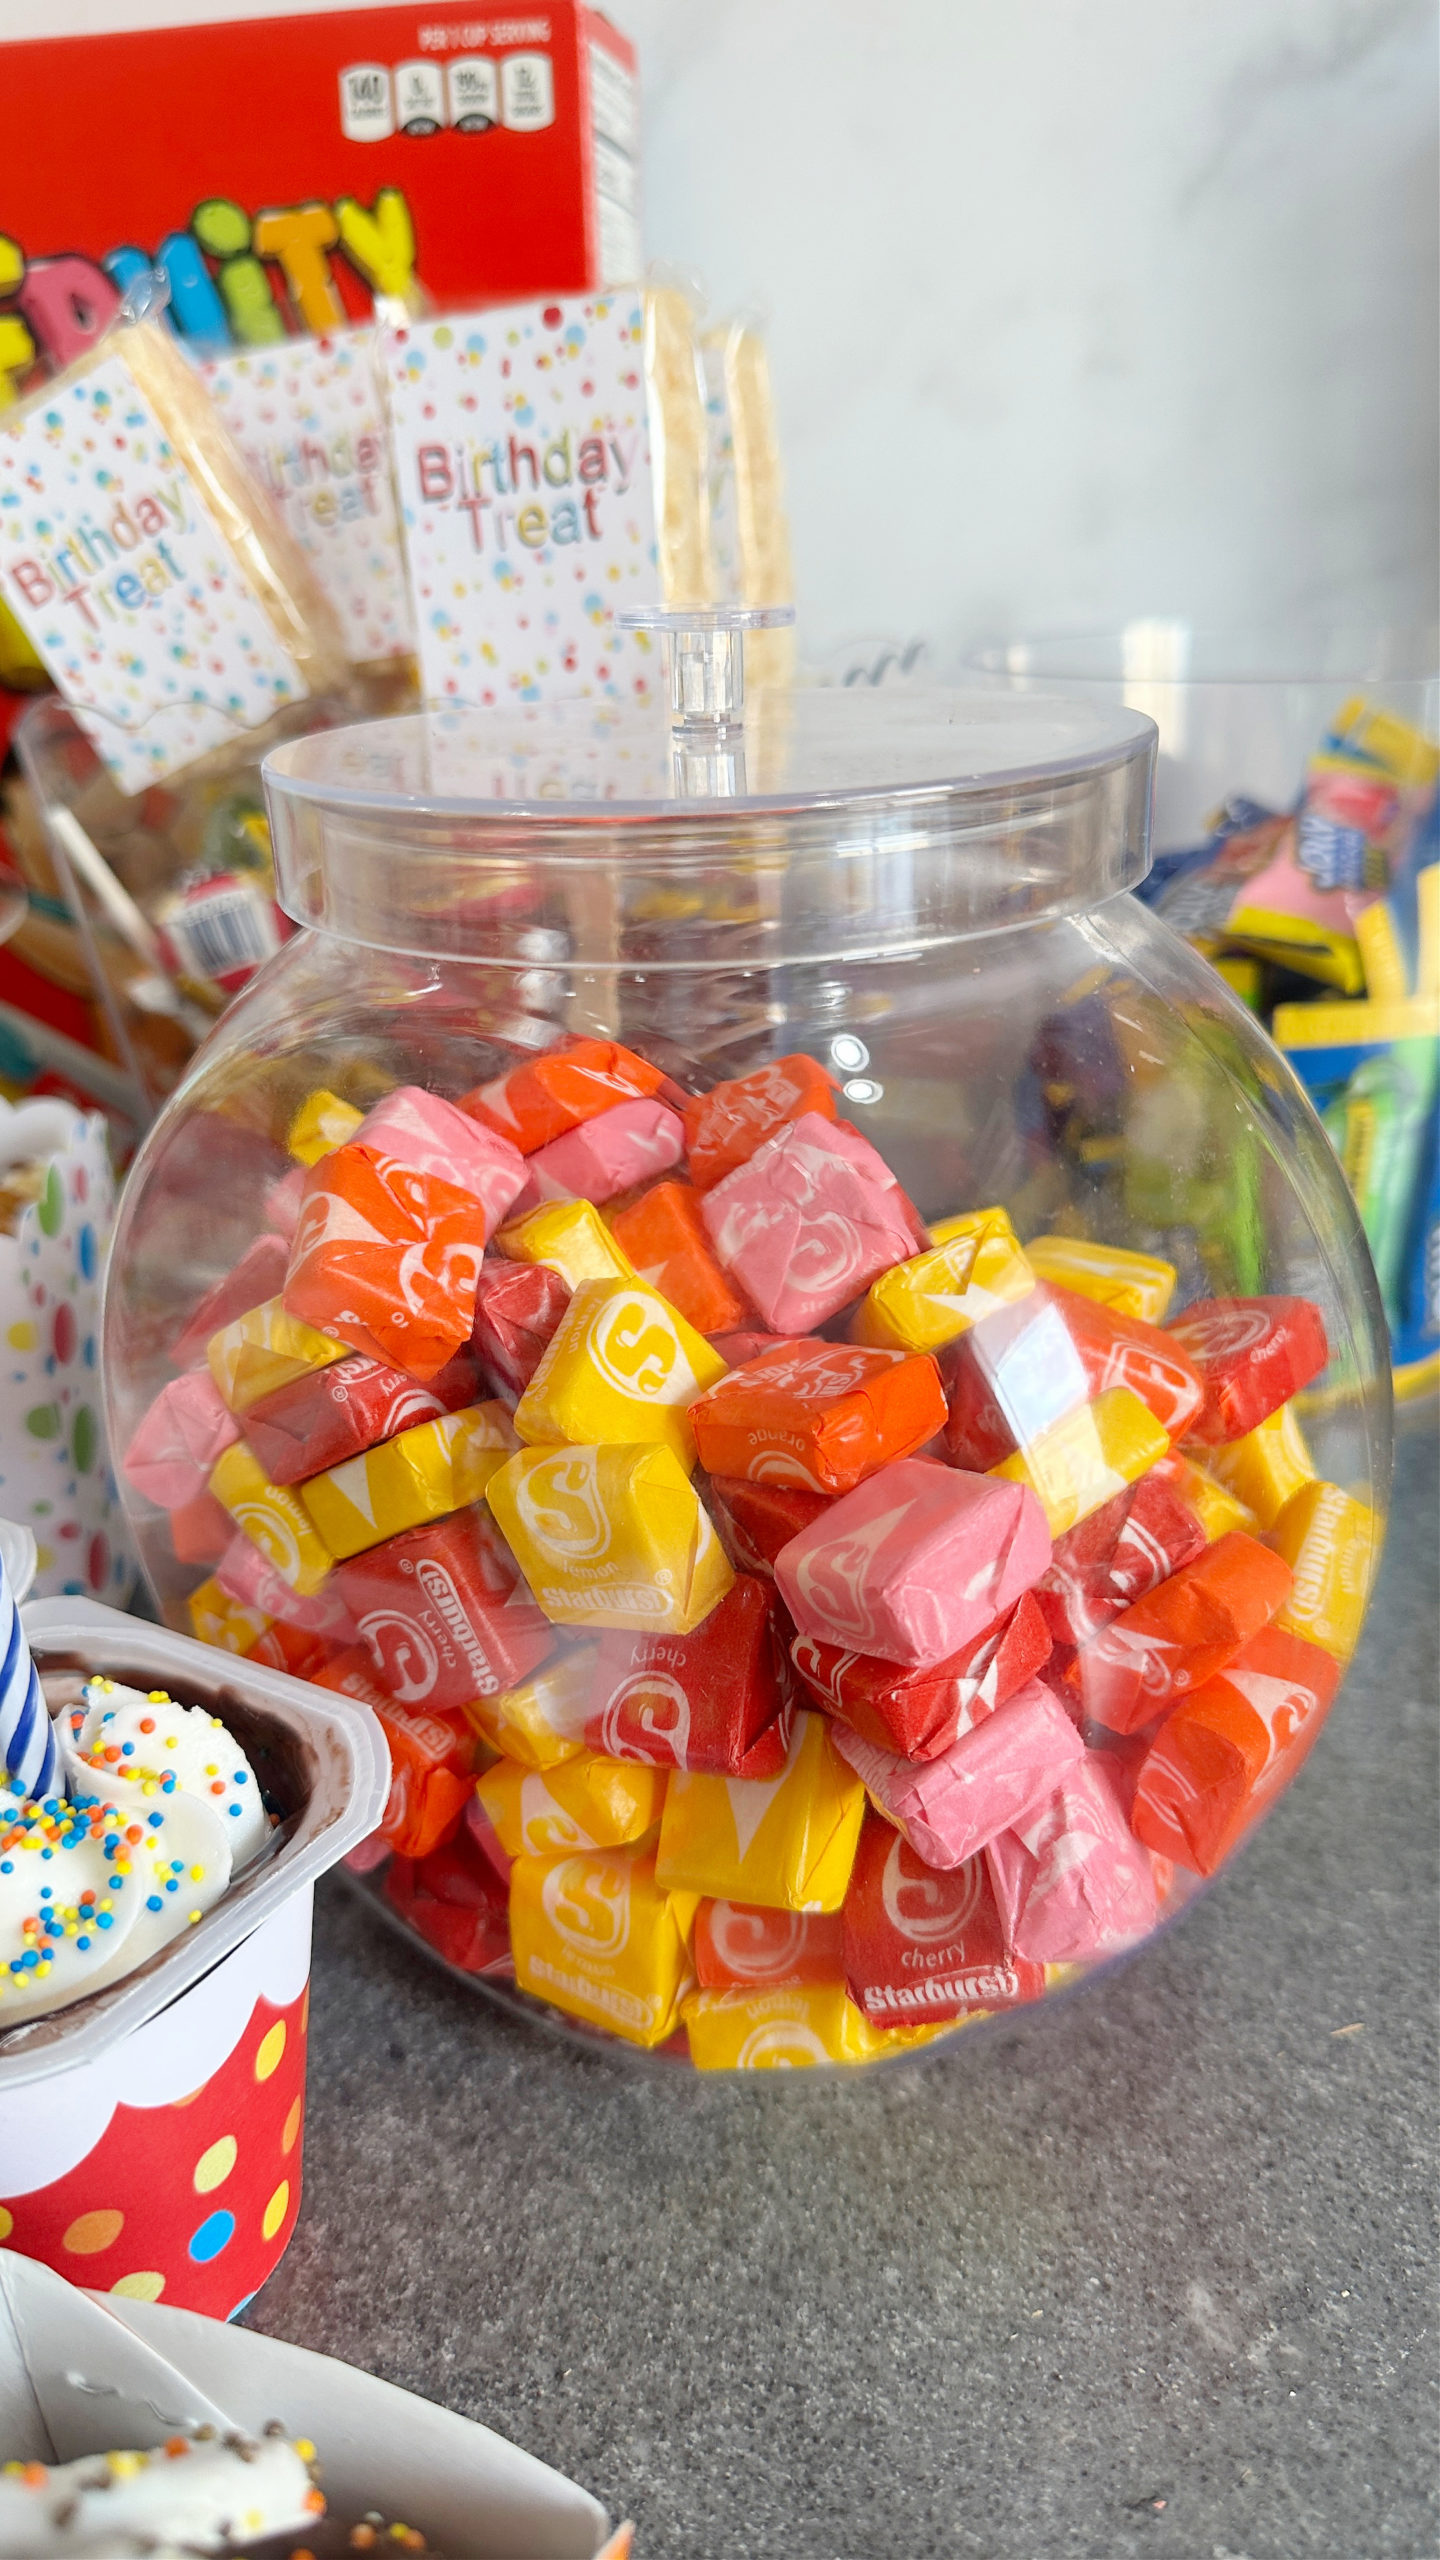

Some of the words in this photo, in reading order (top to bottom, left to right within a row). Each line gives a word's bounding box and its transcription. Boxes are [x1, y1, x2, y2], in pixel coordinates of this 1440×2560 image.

[416, 426, 641, 501] Birthday
[12, 479, 187, 610] Birthday
[458, 487, 602, 553] Treat
[64, 538, 187, 631] Treat
[379, 1371, 408, 1397] erry
[747, 1428, 806, 1452] orange
[264, 1484, 313, 1537] lemon
[562, 1558, 620, 1579] lemon
[1290, 1487, 1349, 1612] Starburst
[541, 1583, 668, 1612] Starburst
[417, 1611, 457, 1669] cherry
[420, 1562, 501, 1695] Starburst
[630, 1646, 687, 1667] cherry
[901, 1940, 966, 1968] cherry
[864, 1968, 1013, 2009] Starburst
